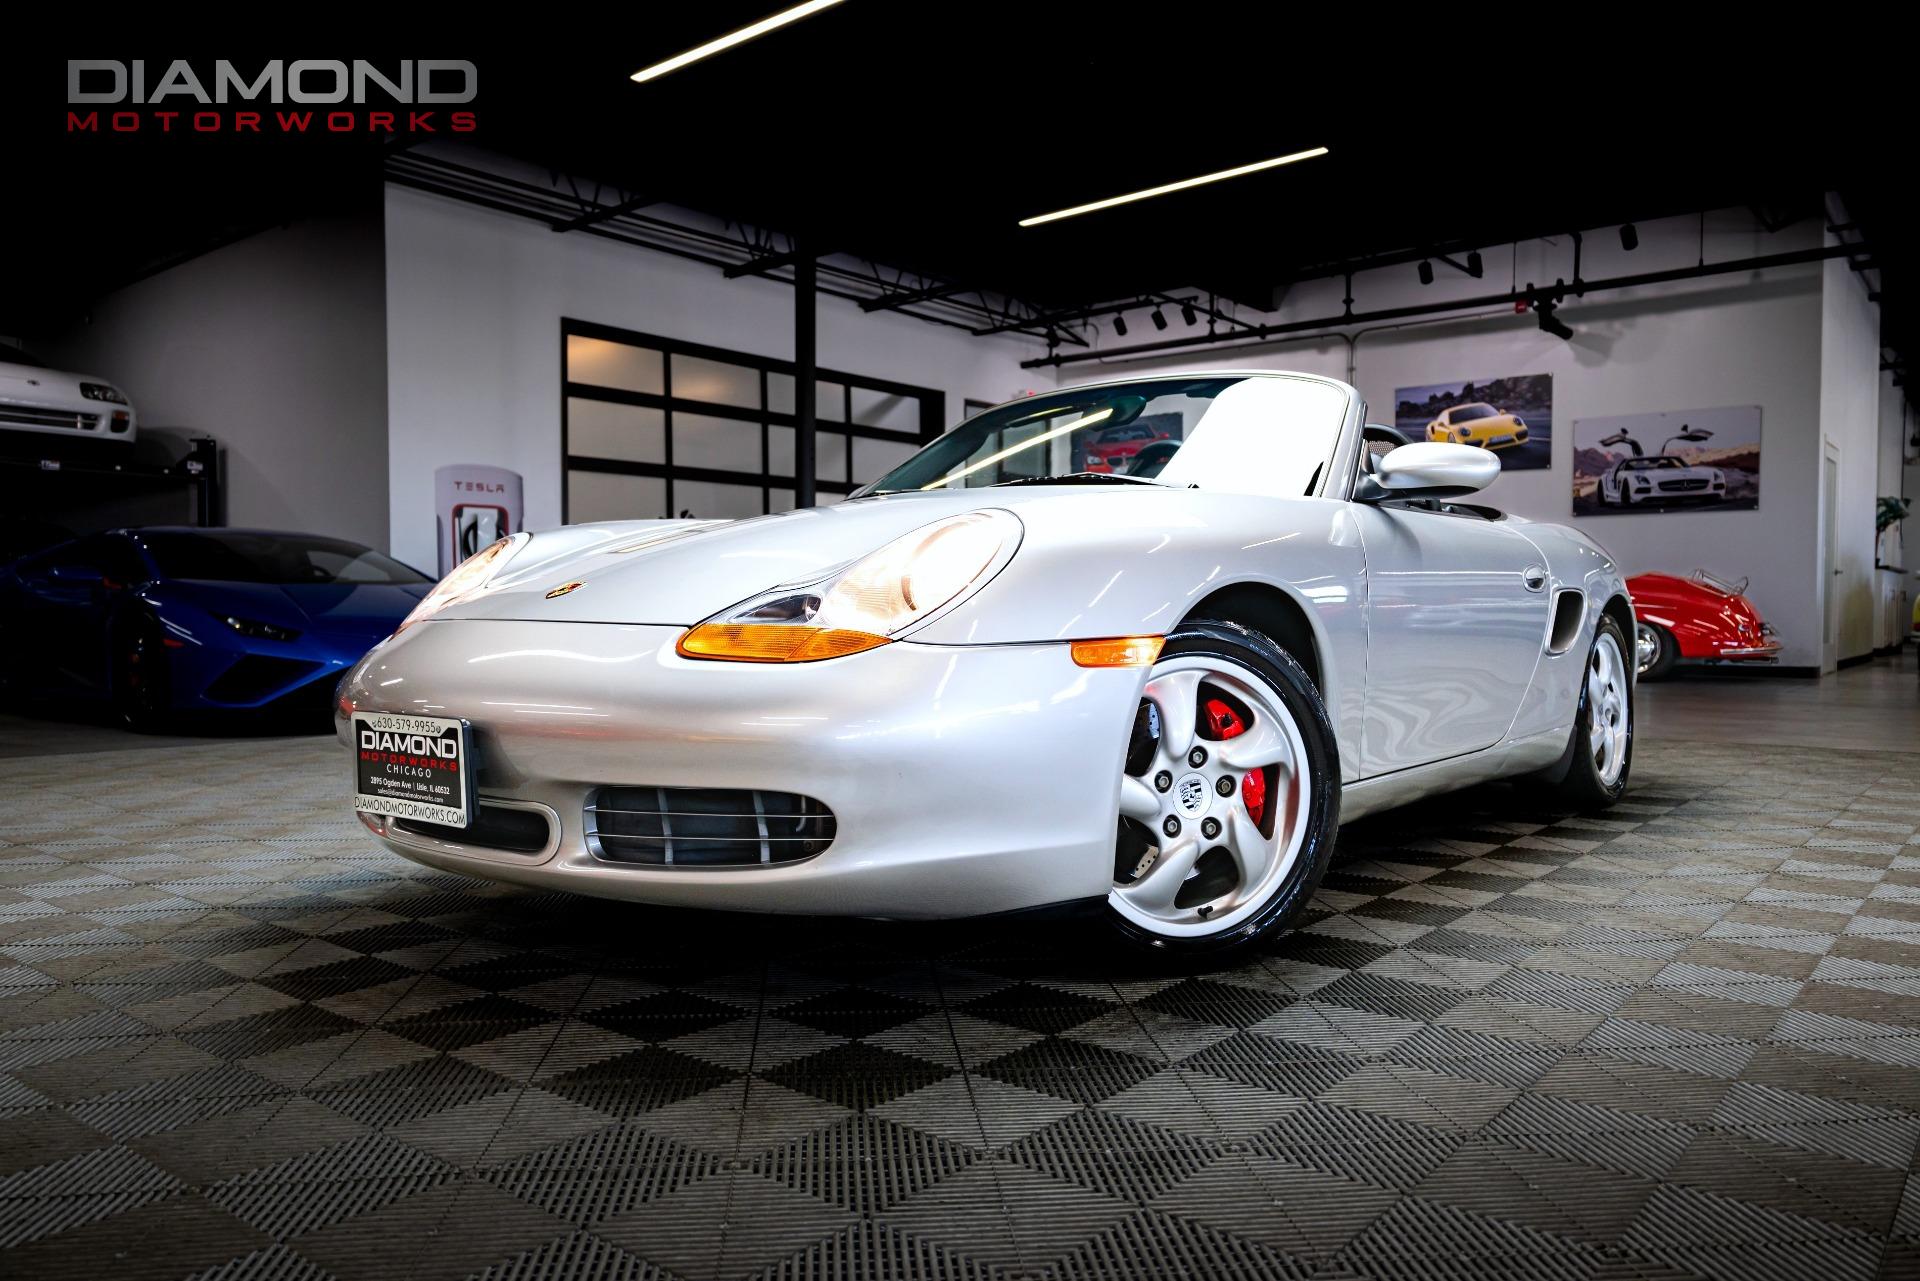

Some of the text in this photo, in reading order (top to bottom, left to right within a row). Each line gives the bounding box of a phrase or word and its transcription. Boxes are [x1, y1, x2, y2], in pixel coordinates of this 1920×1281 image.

[454, 481, 505, 493] TESLA
[377, 717, 436, 733] 630-579-9955
[361, 730, 457, 759] DIAMOND
[361, 752, 457, 771] MOTORWORKS
[386, 765, 431, 778] CHICAGO
[383, 778, 400, 788] Ogden
[401, 780, 411, 789] Ave
[434, 786, 450, 794] 60532
[355, 797, 465, 824] DIAMONDMOTORWORKS.COM
